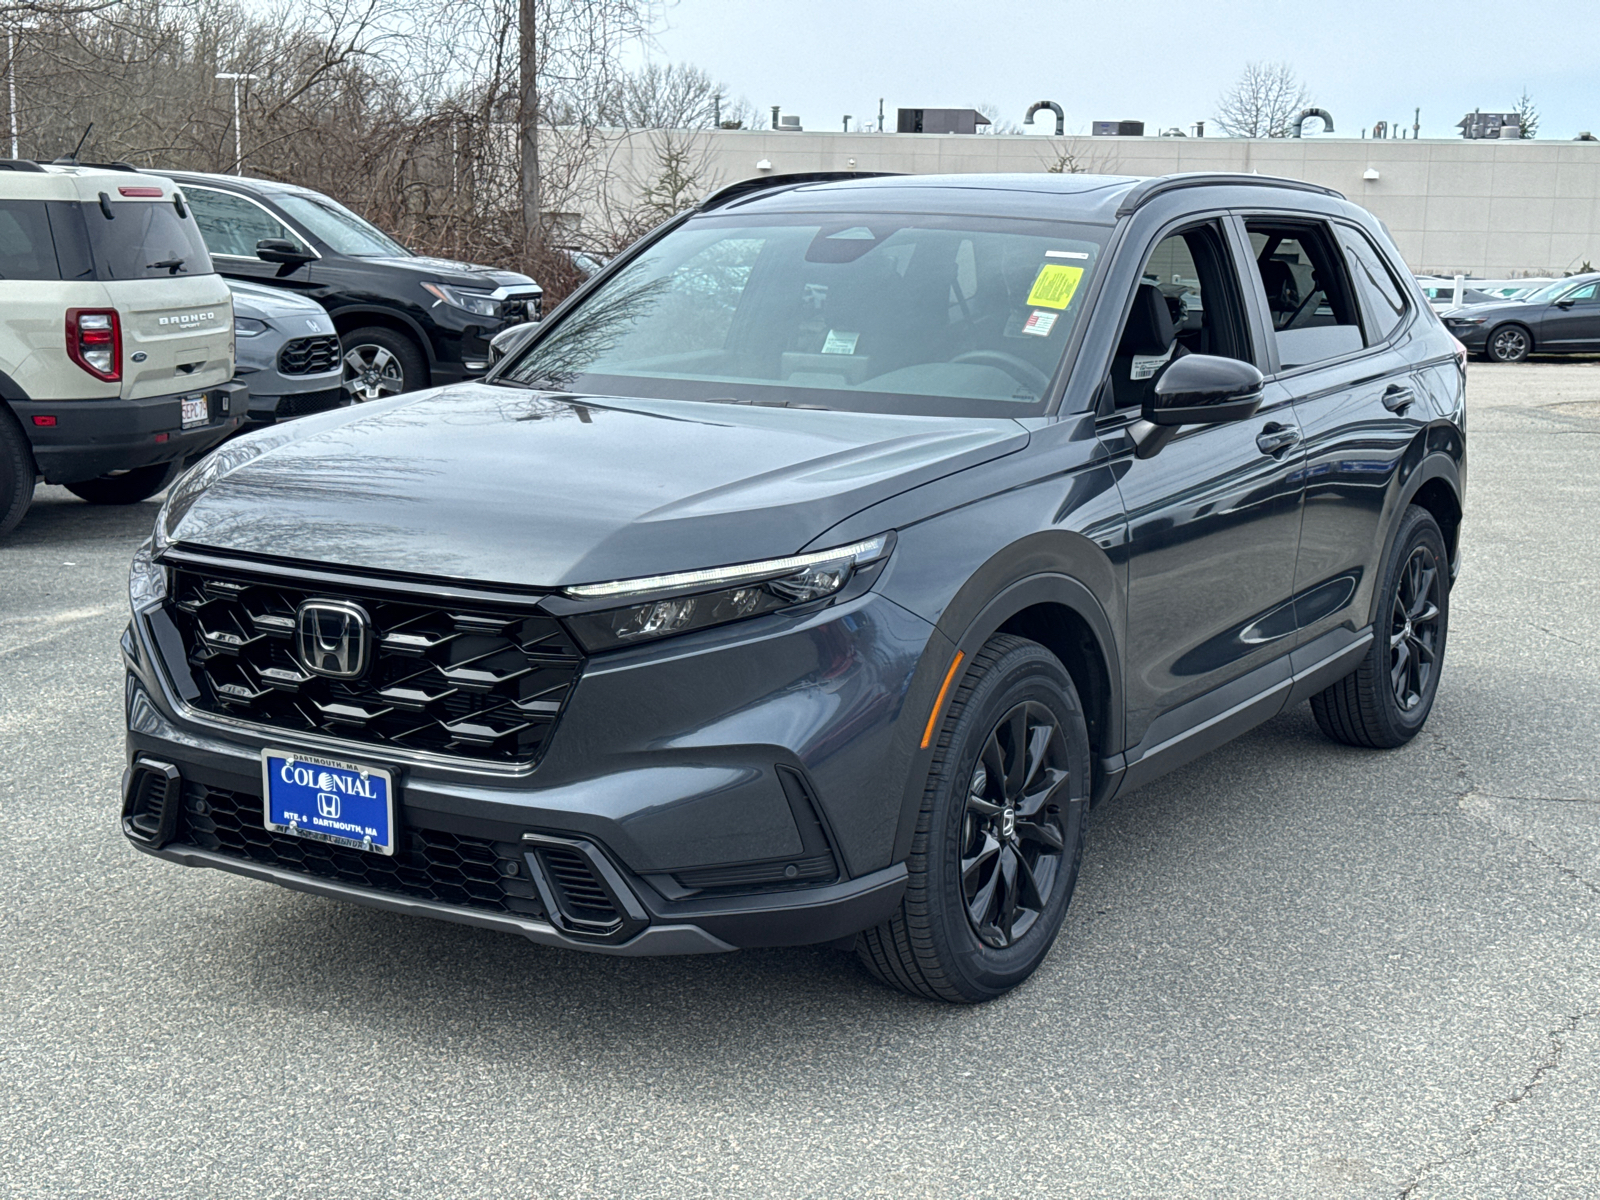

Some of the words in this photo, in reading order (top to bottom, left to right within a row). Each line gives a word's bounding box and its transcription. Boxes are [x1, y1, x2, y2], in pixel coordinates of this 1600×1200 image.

[158, 312, 215, 325] BRONCO
[346, 763, 359, 771] MA
[281, 765, 377, 799] COLONIAL
[283, 811, 301, 821] RTE.
[313, 817, 364, 835] DARTMOUTH,
[365, 827, 378, 836] MA
